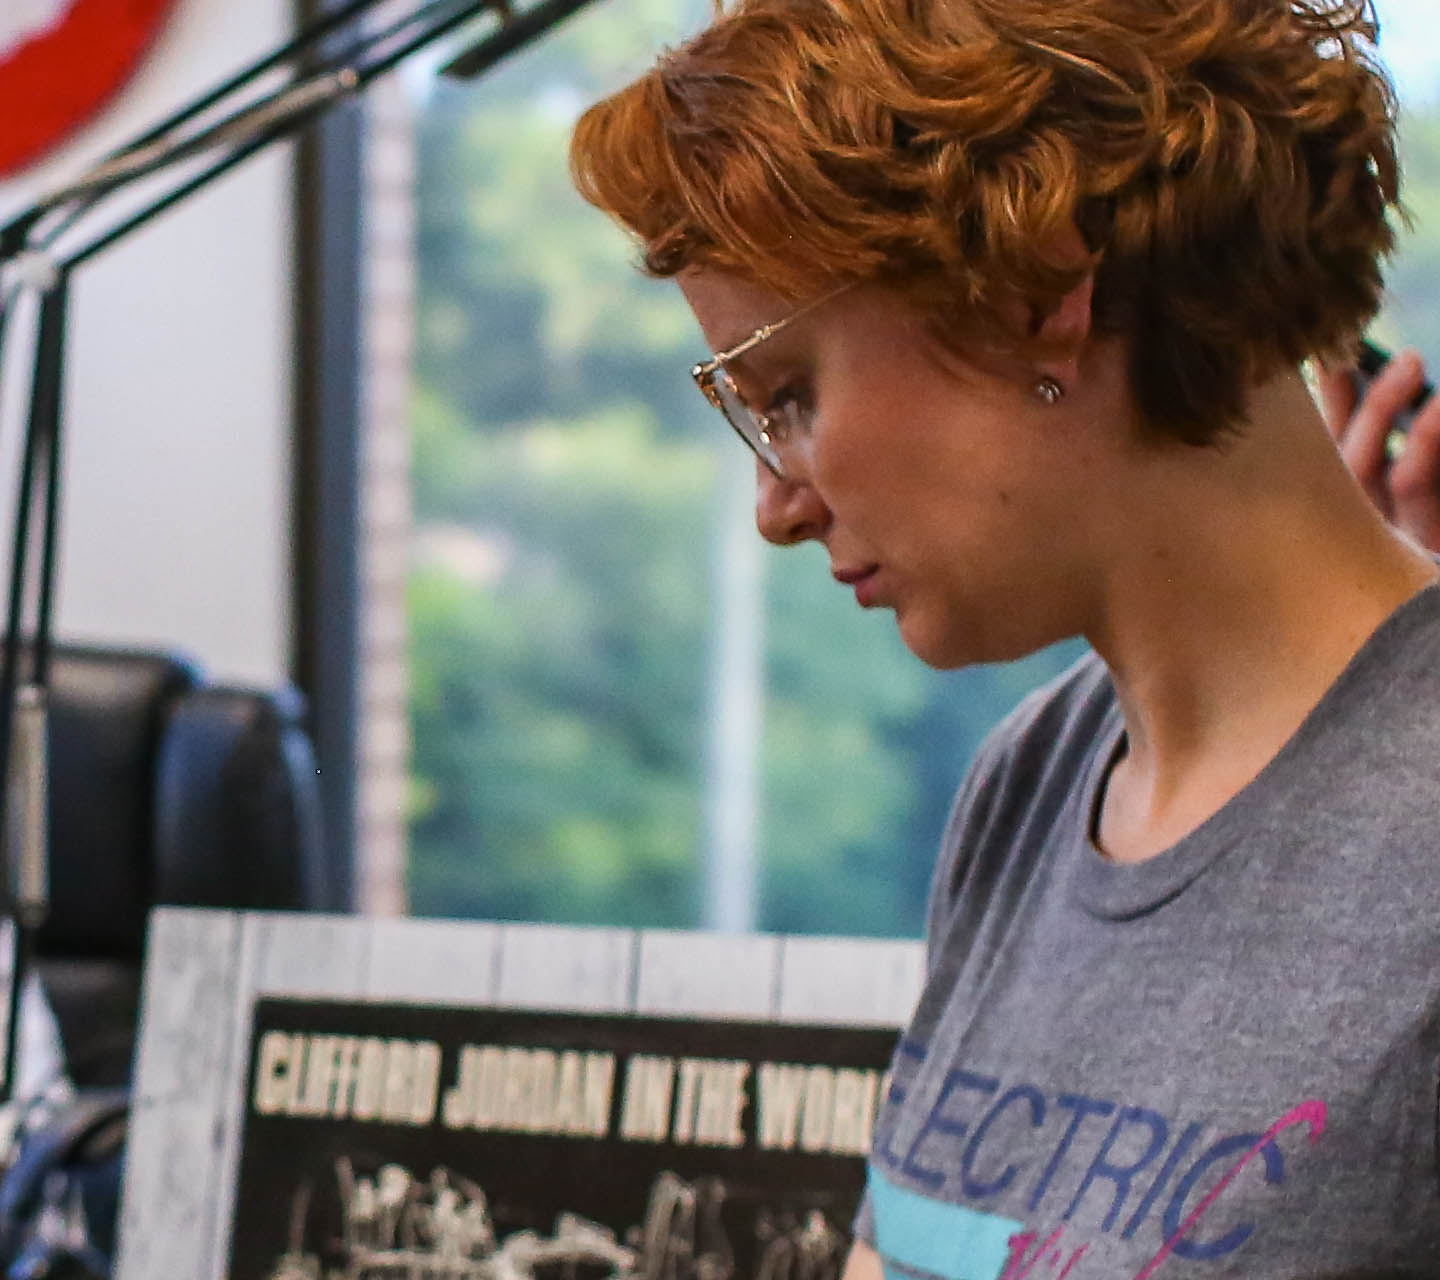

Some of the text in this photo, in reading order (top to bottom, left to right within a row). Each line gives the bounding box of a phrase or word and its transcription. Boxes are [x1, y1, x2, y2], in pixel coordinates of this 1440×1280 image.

[256, 1031, 892, 1157] CLIFFORD JORDAN IN THE WOR
